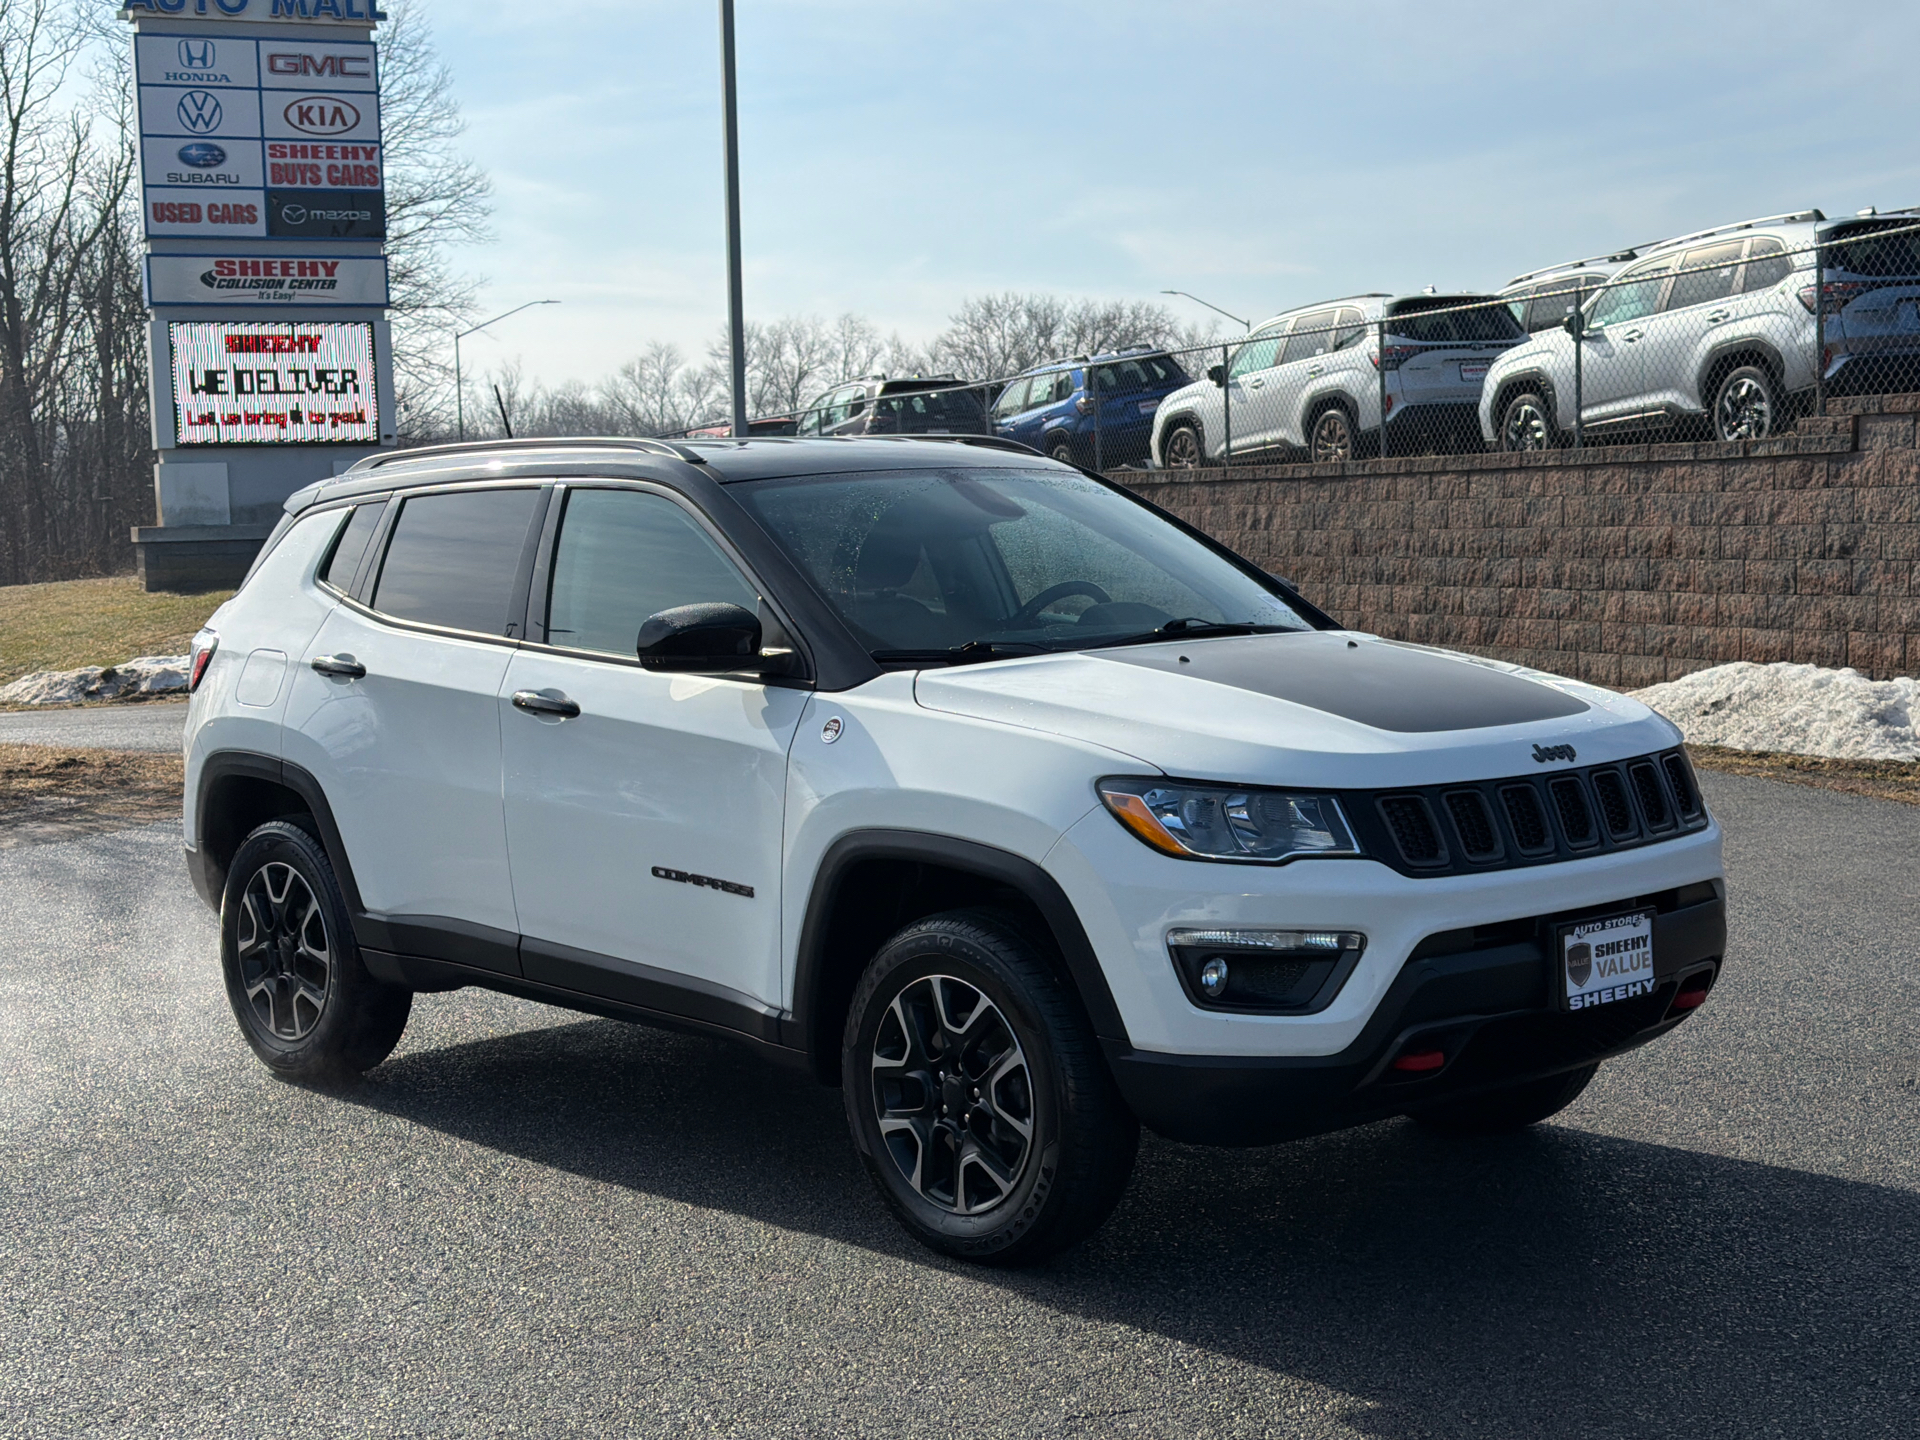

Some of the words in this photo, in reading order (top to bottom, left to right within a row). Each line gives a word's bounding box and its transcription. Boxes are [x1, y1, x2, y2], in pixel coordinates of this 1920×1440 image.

[164, 71, 232, 83] HONDA
[267, 54, 371, 78] GMC
[297, 105, 349, 127] KIA
[268, 143, 378, 161] SHEEHY
[167, 172, 240, 184] SUBARU
[270, 163, 322, 185] BUYS
[327, 164, 379, 187] CARS
[152, 202, 202, 223] USED
[207, 203, 258, 225] CARS
[214, 260, 340, 277] SHEEHY
[216, 278, 286, 290] COLLISION
[288, 279, 338, 290] CENTER
[272, 291, 296, 302] Easy!
[190, 370, 228, 395] WE
[234, 369, 360, 395] DELIVER
[244, 410, 288, 429] bring
[1531, 744, 1577, 763] Jeep
[651, 866, 755, 898] COMPASS
[1573, 922, 1602, 937] AUTO
[1604, 913, 1646, 929] STORES
[1595, 934, 1649, 958] SHEEHY
[1596, 951, 1650, 978] VALUE
[1569, 978, 1656, 1010] SHEEHY
